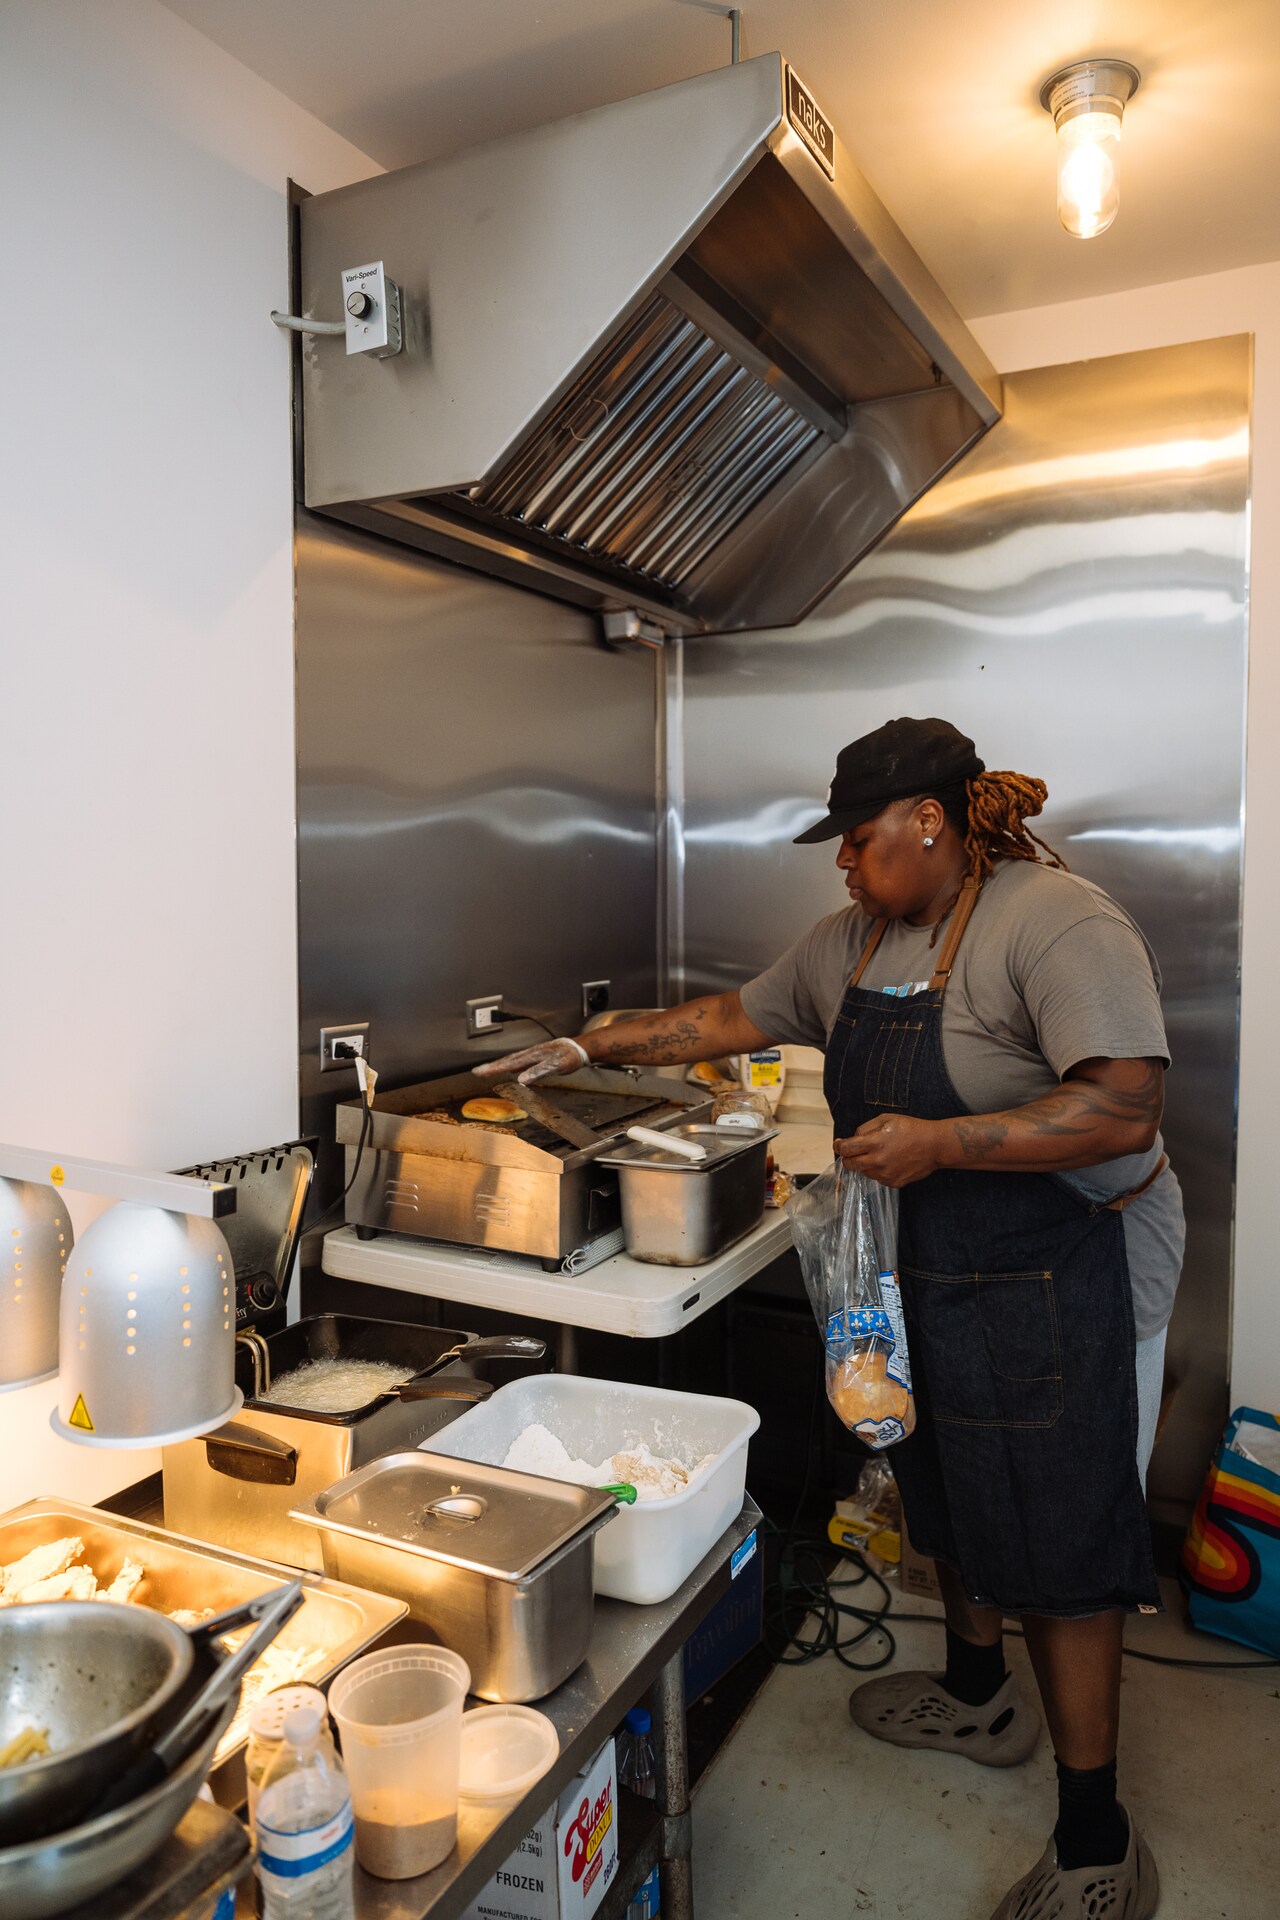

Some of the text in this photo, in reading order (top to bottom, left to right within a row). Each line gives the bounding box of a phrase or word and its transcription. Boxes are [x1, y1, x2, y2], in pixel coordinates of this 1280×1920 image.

[798, 92, 826, 149] naks
[346, 268, 377, 282] Vari-Speed
[564, 1776, 612, 1881] Super
[496, 1871, 544, 1894] FROZEN
[477, 1906, 528, 1920] MANUFACTURED
